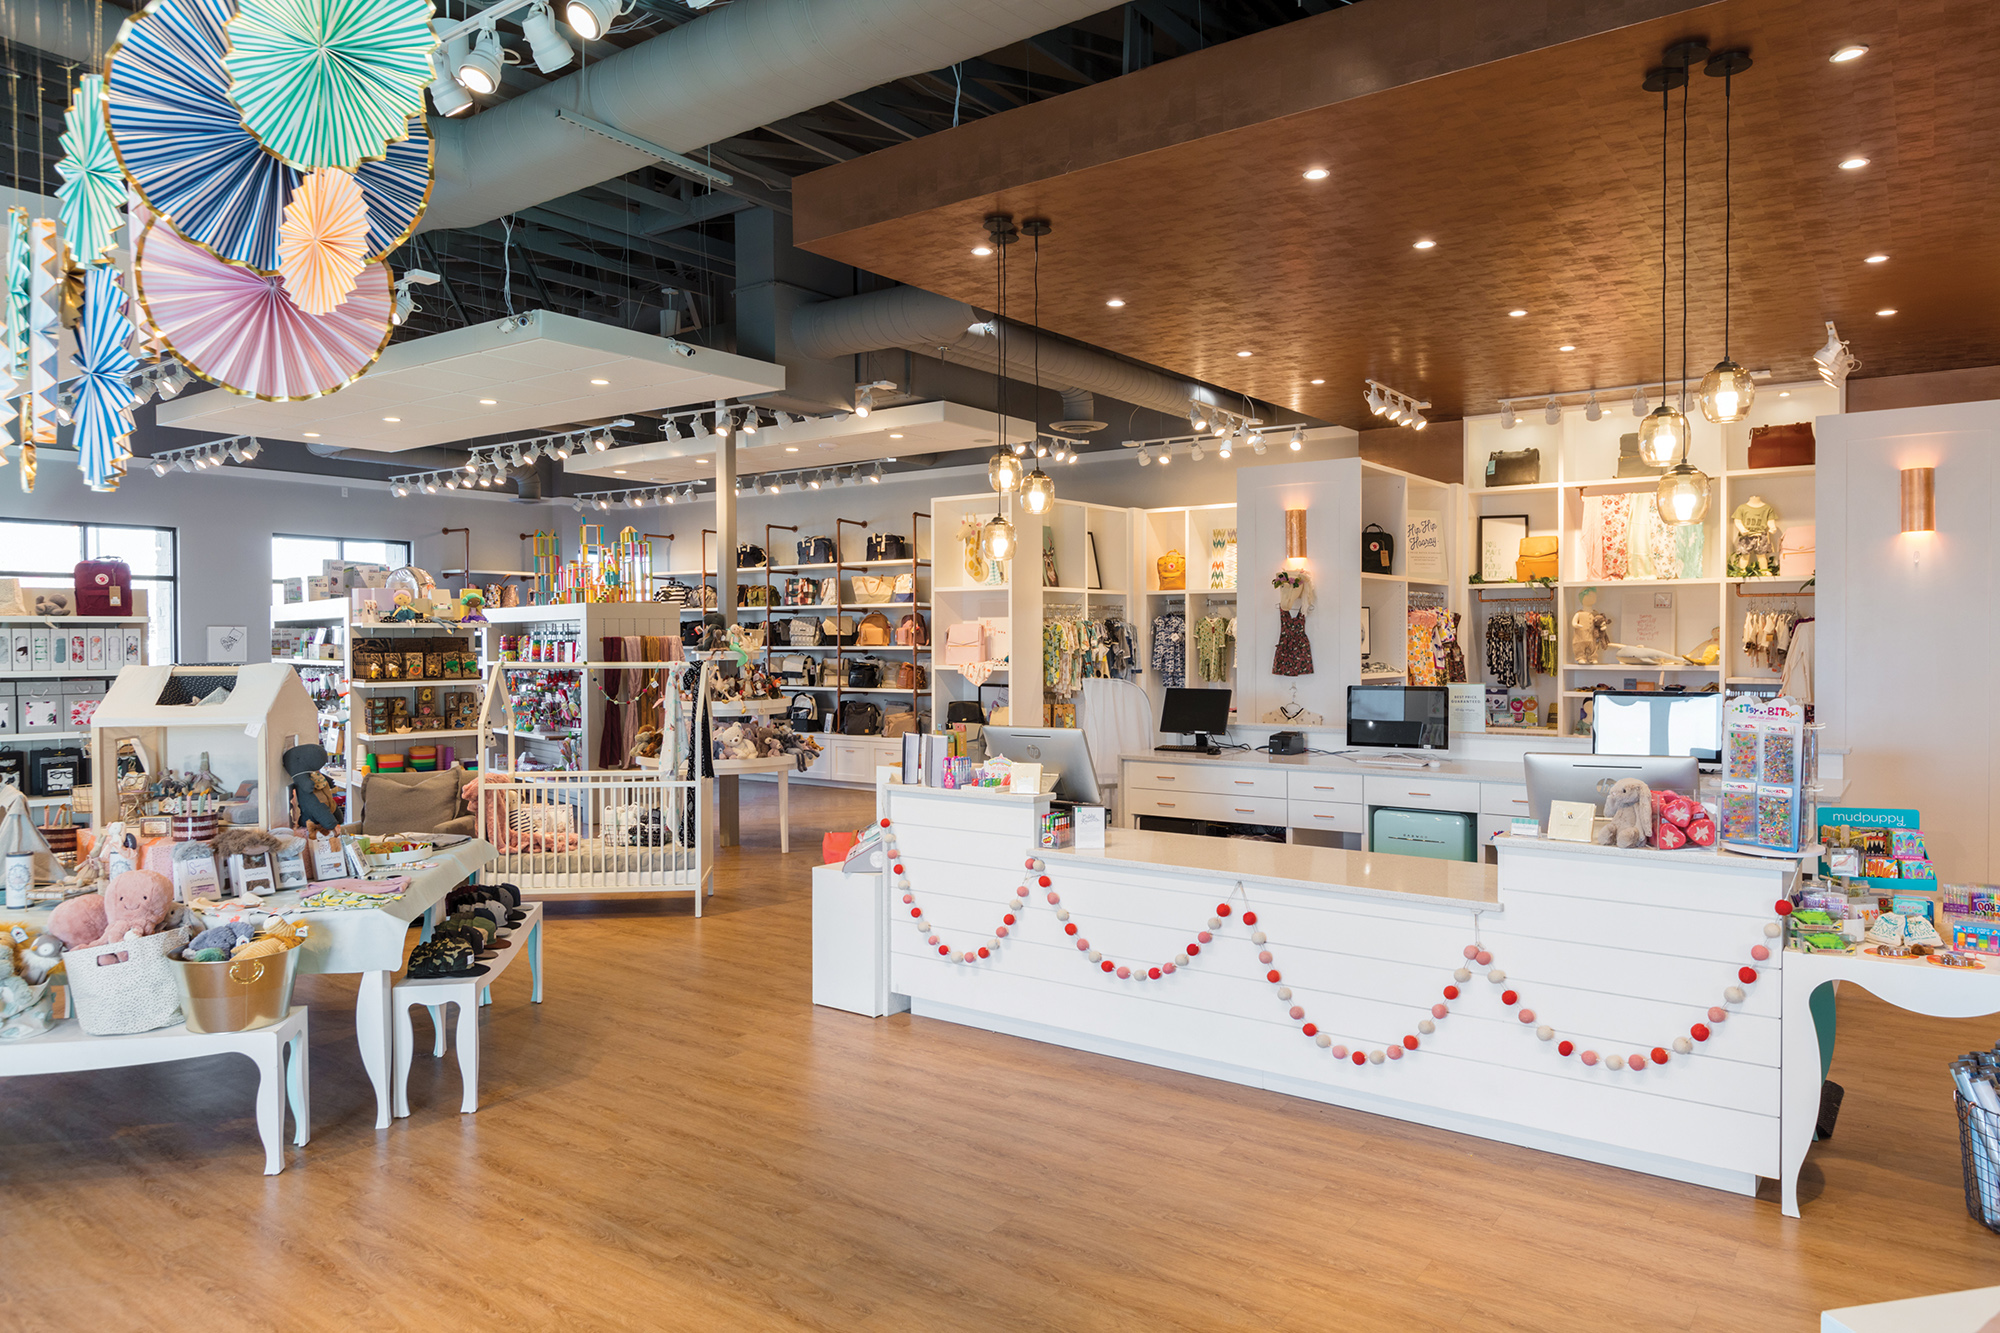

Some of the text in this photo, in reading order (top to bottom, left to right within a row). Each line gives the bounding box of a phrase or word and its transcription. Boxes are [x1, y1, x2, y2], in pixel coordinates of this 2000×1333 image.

[1421, 519, 1437, 533] Hip
[1028, 744, 1040, 760] hp
[1832, 812, 1906, 827] mudpuppy
